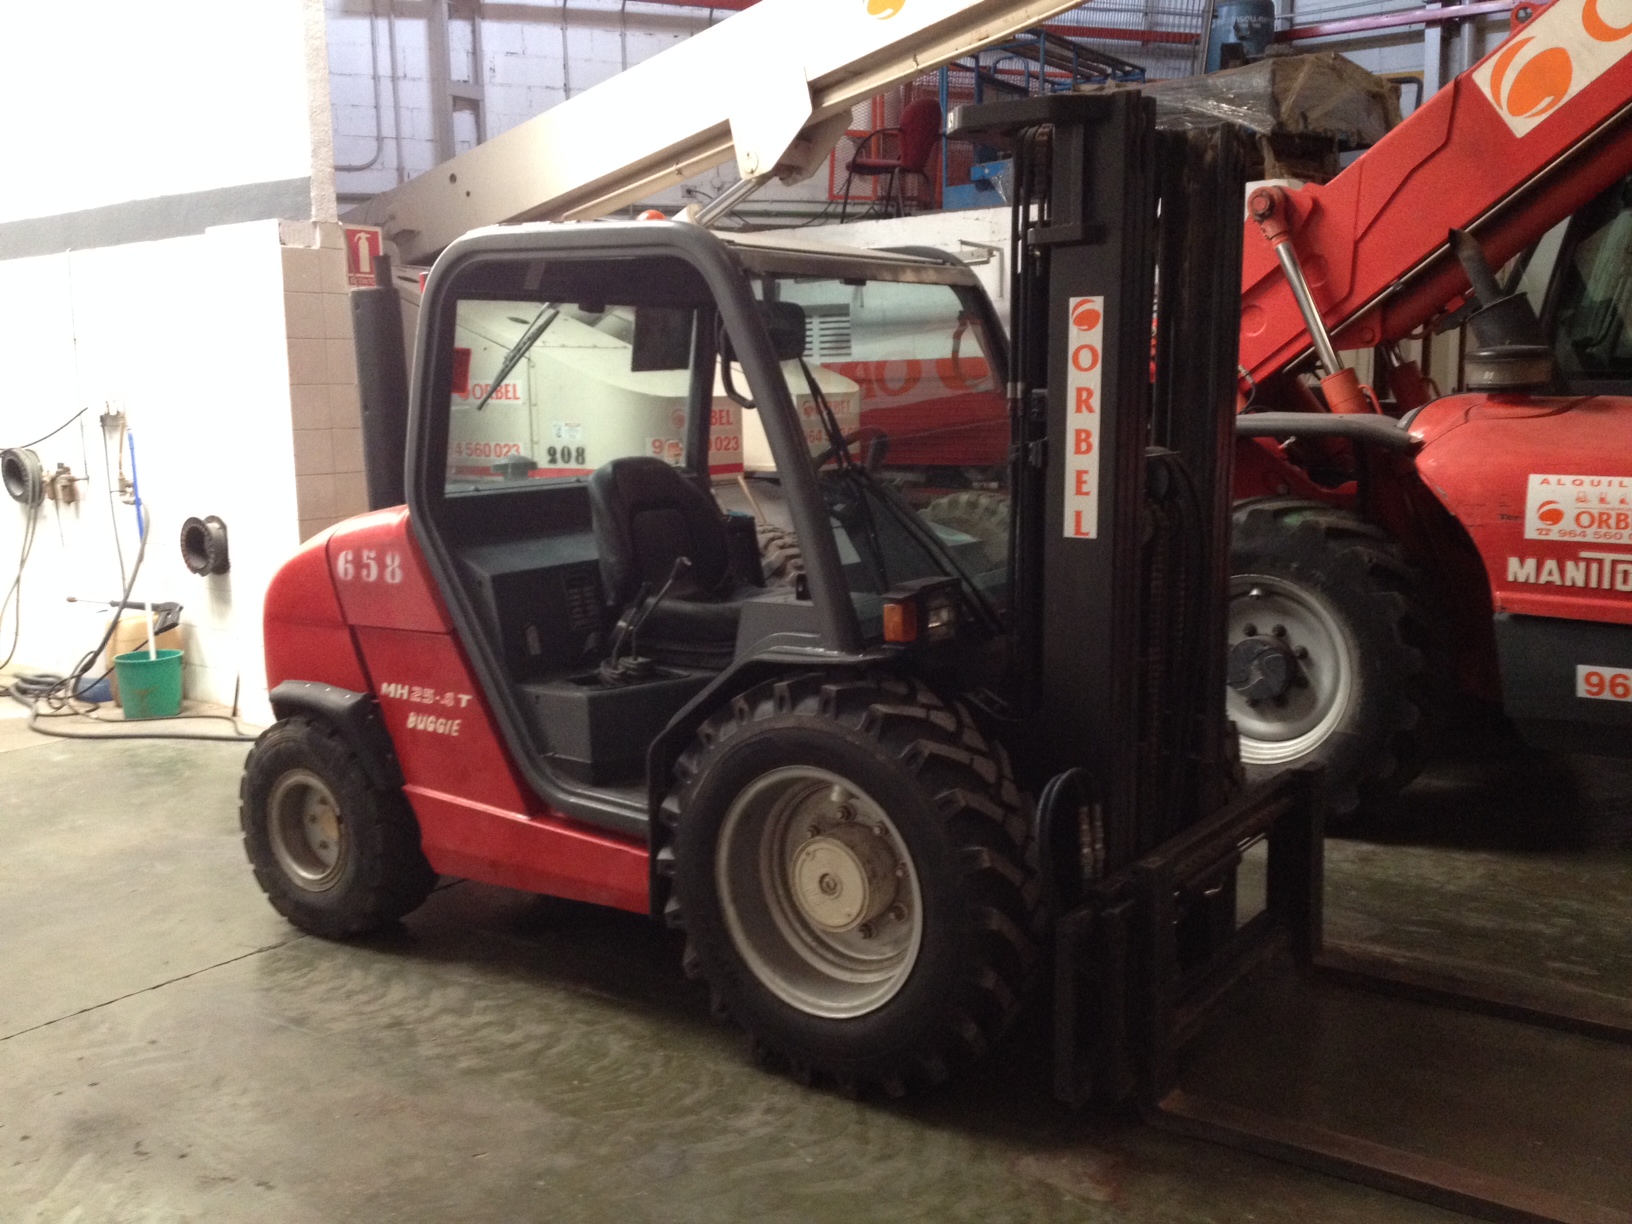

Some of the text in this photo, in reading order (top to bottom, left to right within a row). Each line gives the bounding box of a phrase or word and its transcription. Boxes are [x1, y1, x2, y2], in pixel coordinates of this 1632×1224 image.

[465, 442, 491, 457] 560
[715, 436, 739, 452] 023
[1071, 343, 1100, 538] ORBEL
[547, 445, 586, 465] 208
[1540, 478, 1628, 488] ALQUIL
[337, 549, 403, 584] 658
[1584, 671, 1631, 699] 96
[406, 712, 461, 737] BUGGIE
